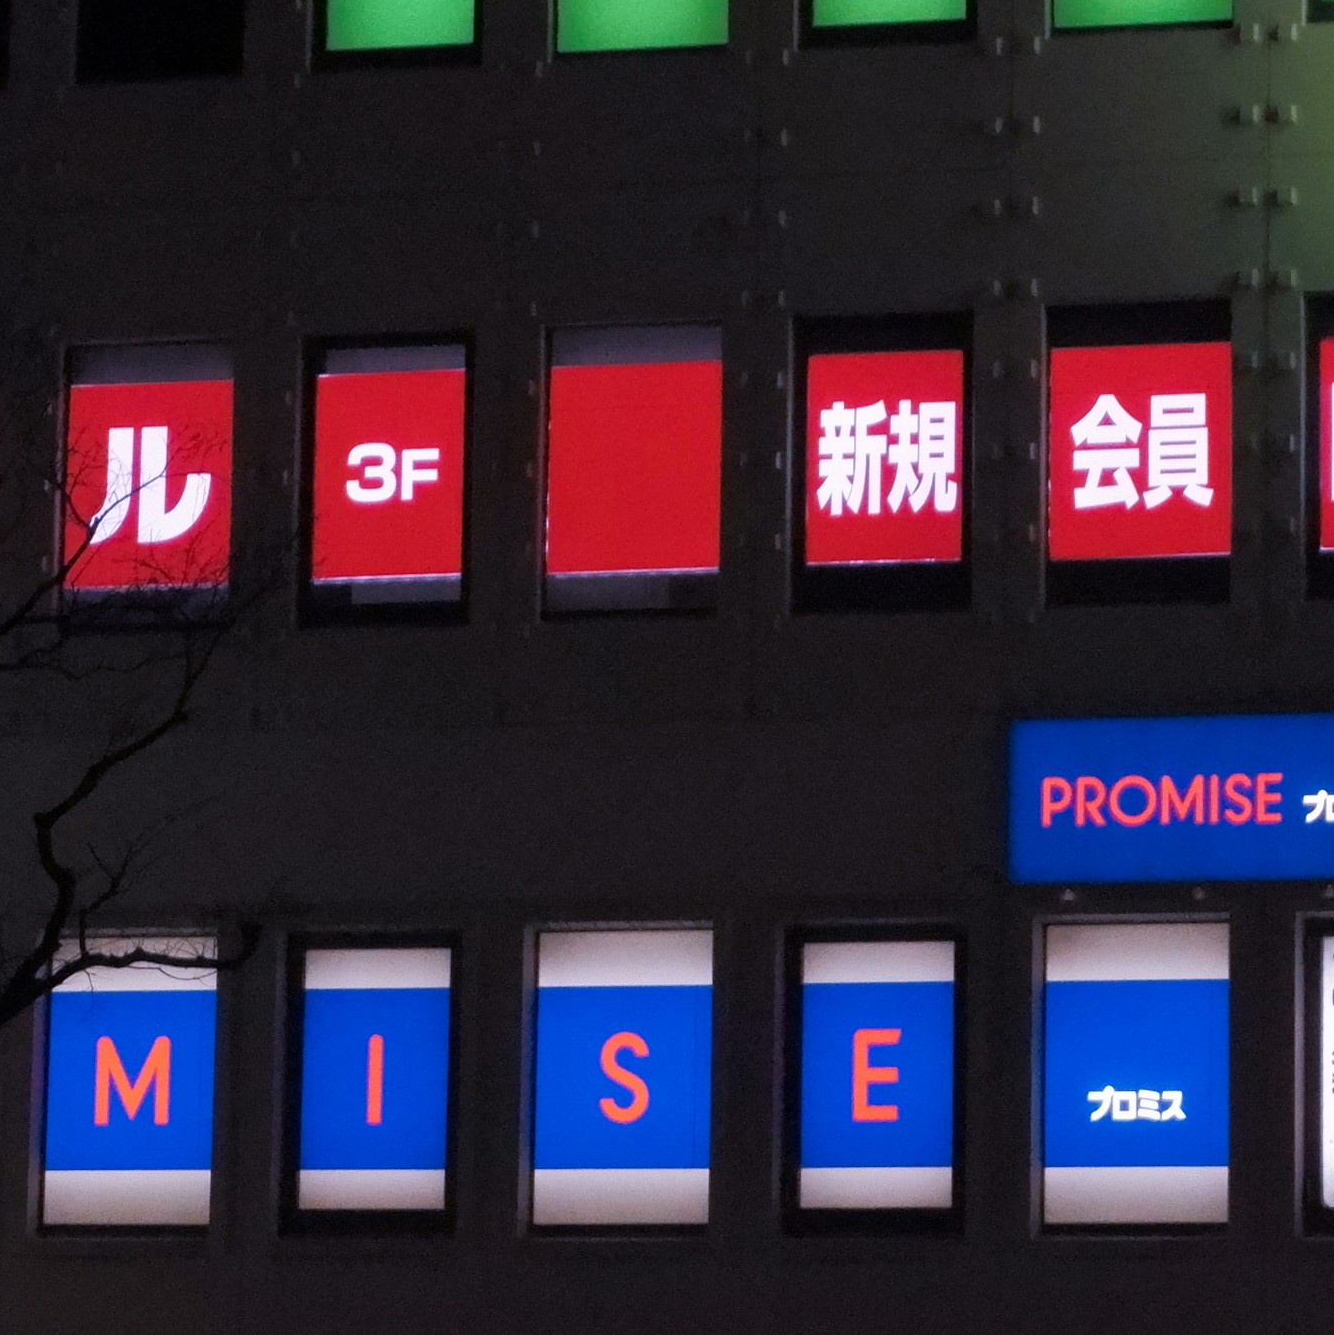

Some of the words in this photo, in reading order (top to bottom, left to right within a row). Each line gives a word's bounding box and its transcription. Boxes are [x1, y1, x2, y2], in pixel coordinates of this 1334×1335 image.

[345, 442, 440, 504] 3F
[1041, 772, 1284, 828] PROMISE
[1087, 1084, 1187, 1123] プロミス
